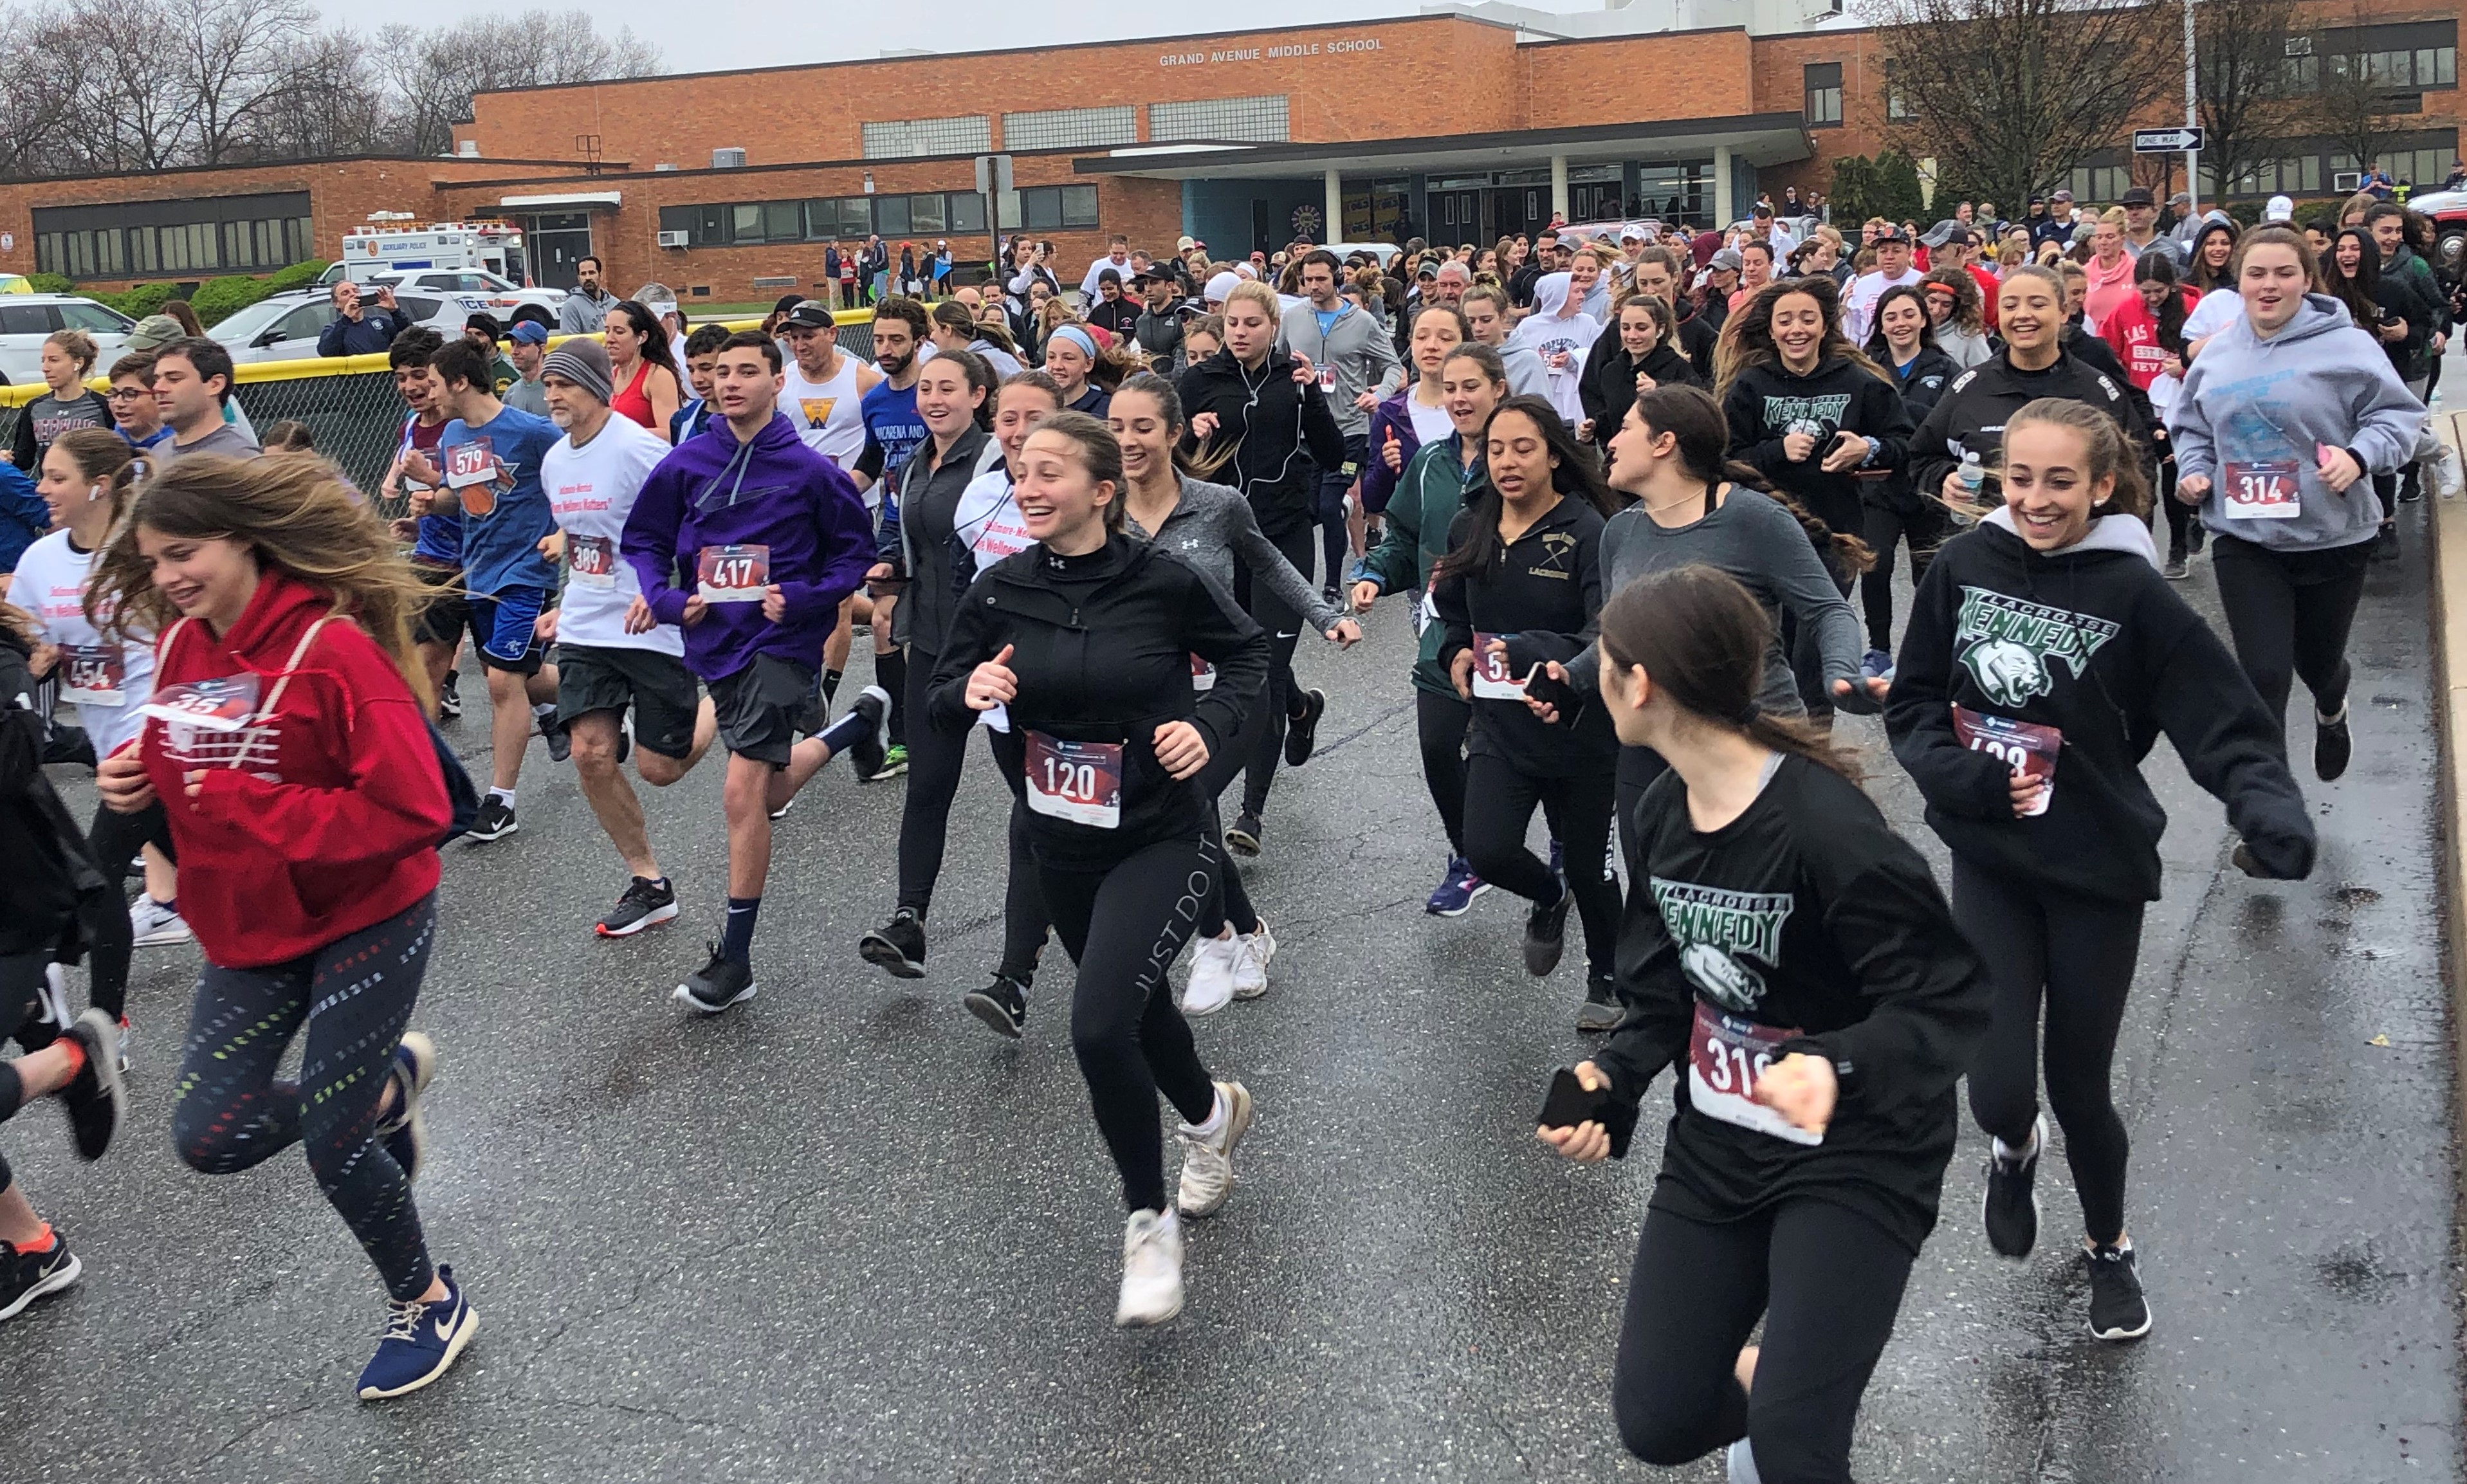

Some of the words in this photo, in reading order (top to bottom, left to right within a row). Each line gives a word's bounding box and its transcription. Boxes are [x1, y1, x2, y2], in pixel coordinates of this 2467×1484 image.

[1160, 55, 1204, 66] GRAND
[1211, 49, 1260, 62] AVENUE
[1268, 44, 1319, 58] MIDDLE
[1327, 39, 1384, 53] SCHOOL
[2140, 136, 2158, 145] ONE
[2123, 324, 2148, 344] LAS
[908, 425, 925, 439] AND
[457, 450, 482, 473] 579
[2240, 476, 2282, 501] 314
[574, 545, 601, 572] 389
[713, 559, 753, 586] 417
[1989, 594, 2114, 635] LACROSSE
[1959, 585, 2107, 680] KENNEDY
[72, 661, 108, 688] 454
[1044, 757, 1095, 800] 120
[1135, 919, 1180, 1002] JUST
[1175, 870, 1210, 922] DO
[1198, 833, 1218, 864] IT
